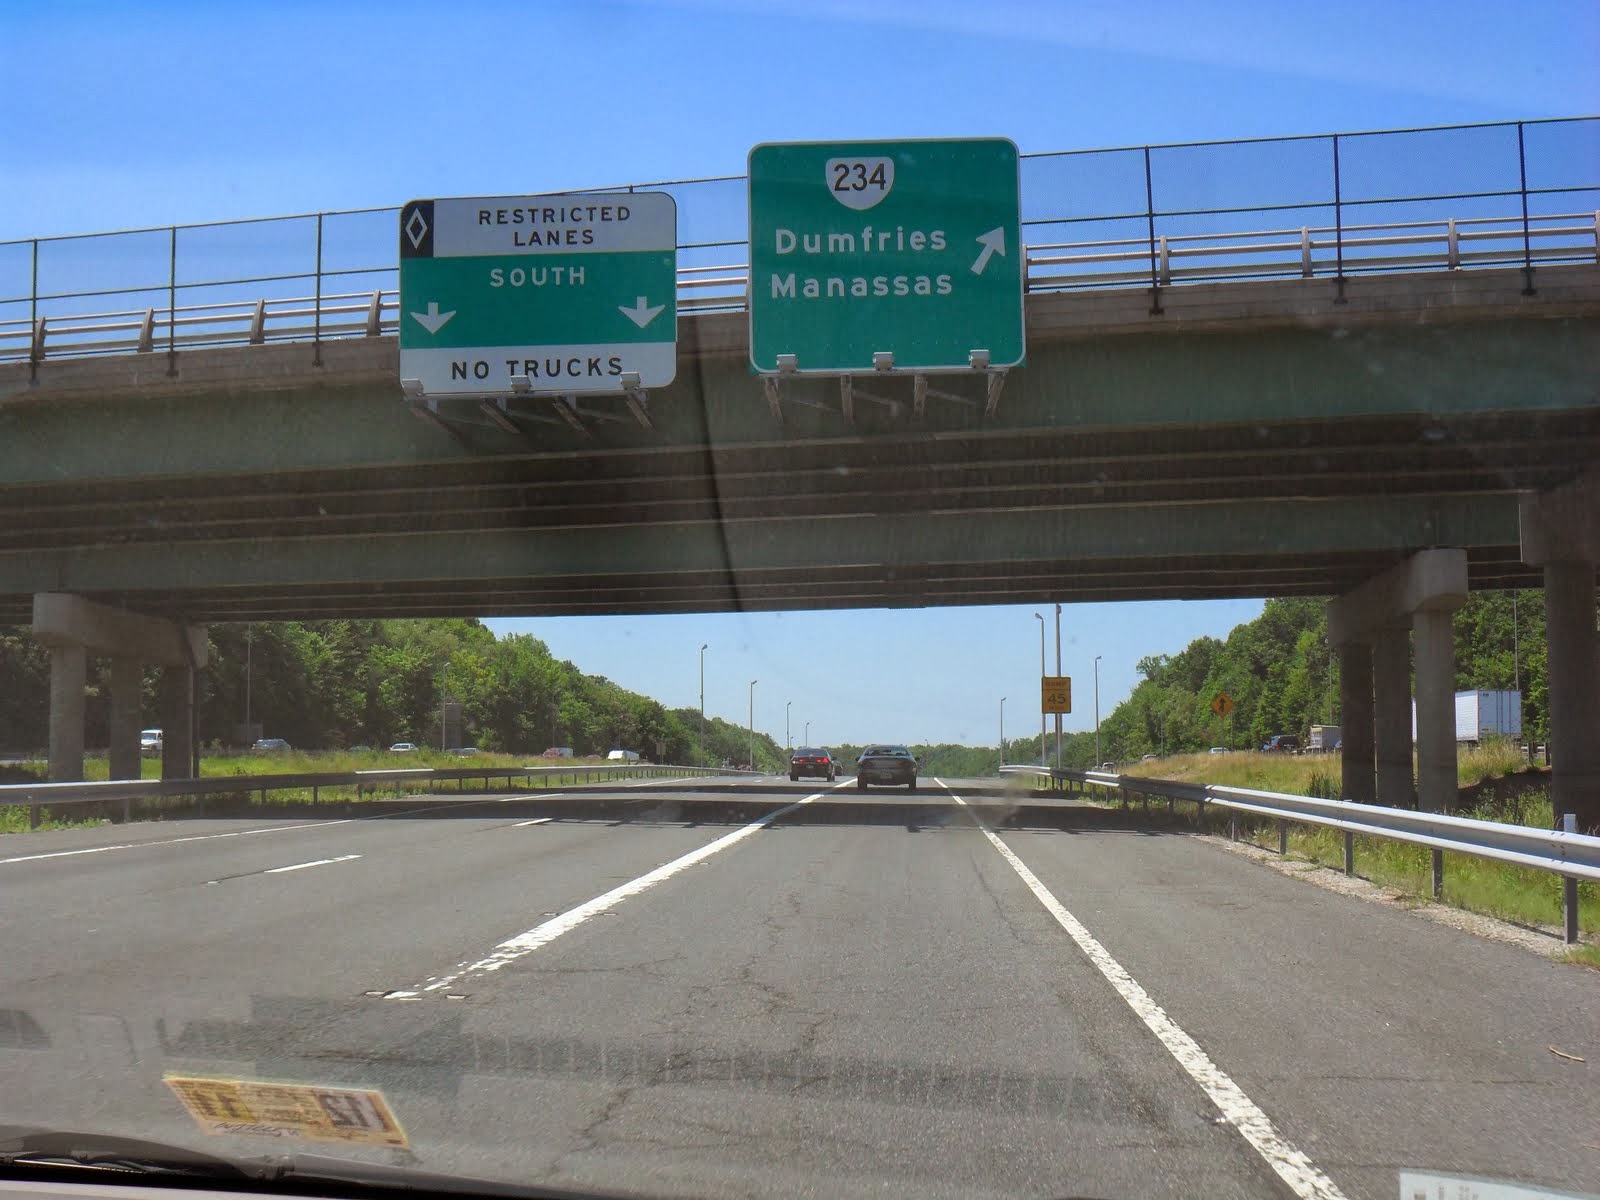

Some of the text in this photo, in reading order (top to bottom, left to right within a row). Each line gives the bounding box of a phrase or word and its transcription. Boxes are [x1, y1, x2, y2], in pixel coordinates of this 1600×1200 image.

[834, 163, 886, 191] 234
[479, 206, 631, 225] RESTRICTED
[514, 229, 594, 247] LANES
[775, 226, 947, 254] Dumfries
[489, 266, 585, 287] SOUTH
[771, 273, 952, 299] Manassas
[452, 357, 623, 380] NO TRUCKS
[1047, 693, 1066, 704] 45
